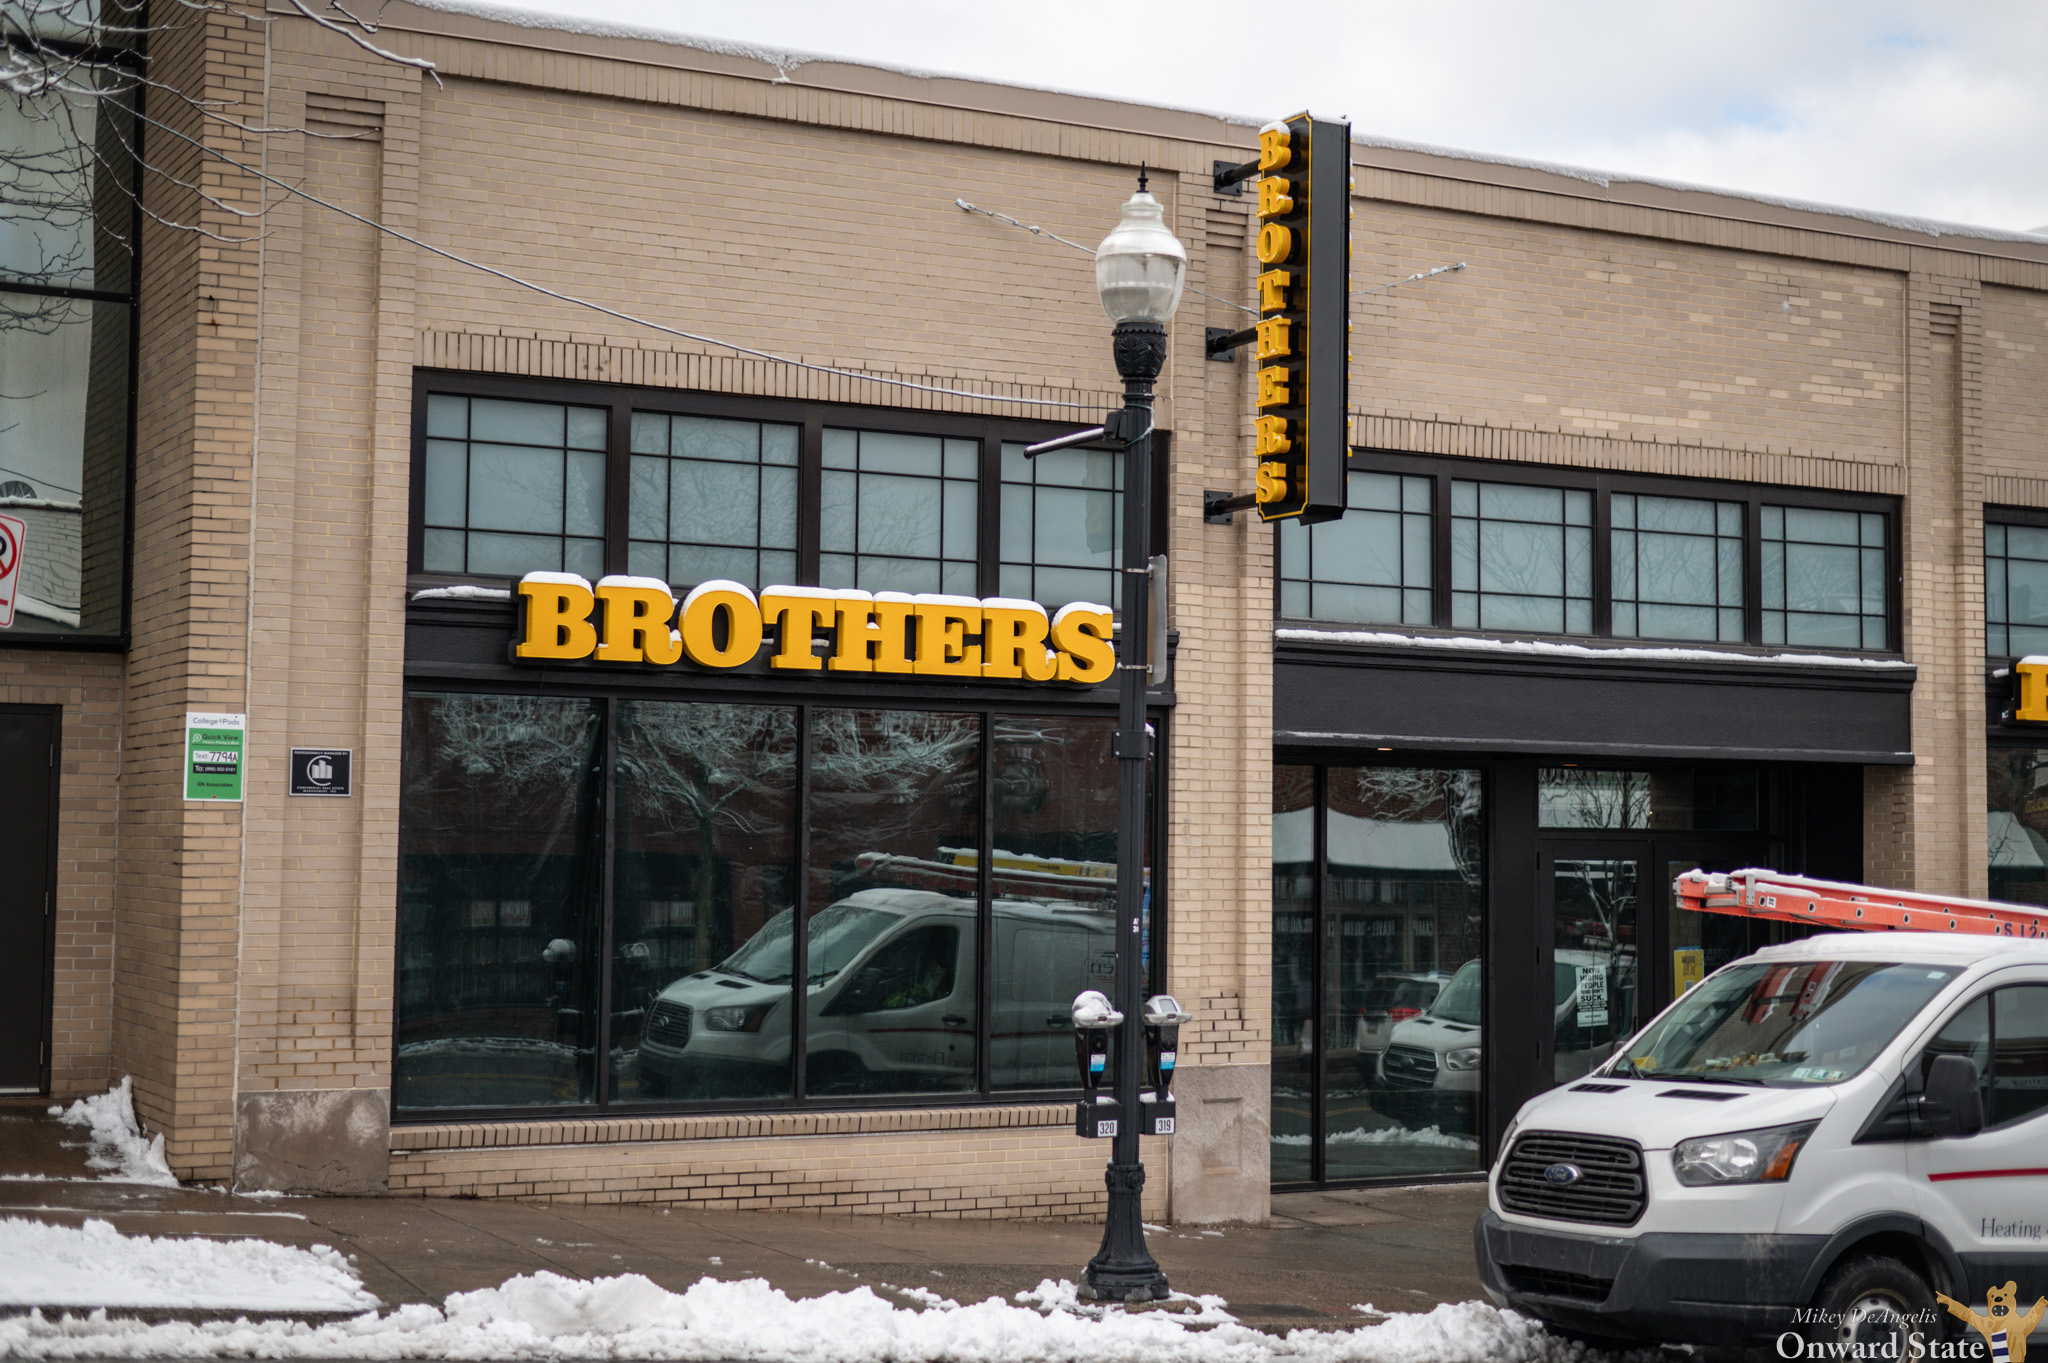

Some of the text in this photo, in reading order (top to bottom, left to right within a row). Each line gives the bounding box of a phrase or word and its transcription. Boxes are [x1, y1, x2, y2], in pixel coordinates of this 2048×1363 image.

[1255, 127, 1293, 503] BROTHERS
[516, 580, 1115, 683] BROTHERS
[1581, 981, 1604, 989] PEOPLE
[1100, 1122, 1114, 1134] 320
[1158, 1120, 1171, 1131] 319
[1981, 1218, 2041, 1243] Heating
